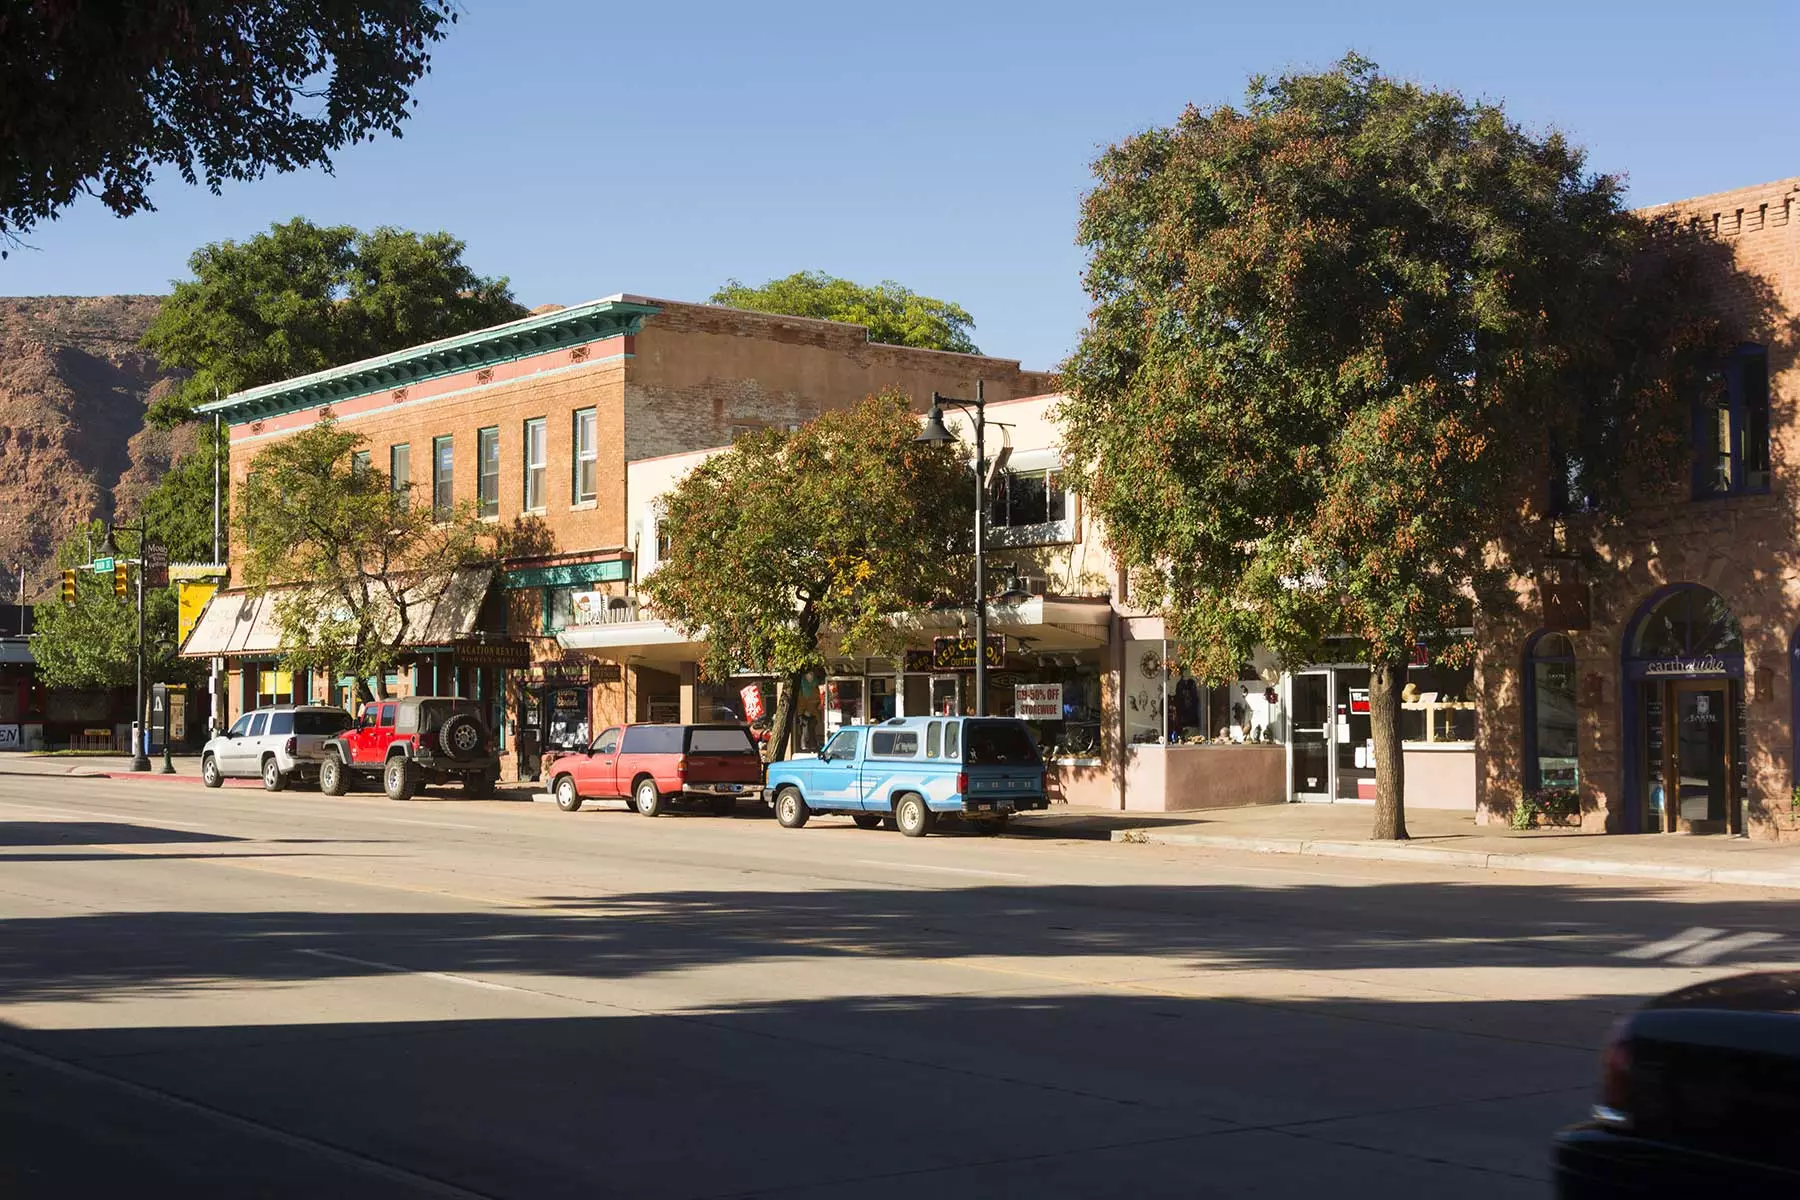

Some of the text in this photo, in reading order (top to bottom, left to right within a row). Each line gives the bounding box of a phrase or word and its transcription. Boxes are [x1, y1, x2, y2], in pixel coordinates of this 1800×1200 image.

[146, 543, 168, 554] Moab
[576, 608, 634, 626] URANIUM
[456, 645, 495, 656] VACATION
[937, 639, 1001, 666] RED CANON
[1047, 688, 1060, 700] OFF
[1020, 703, 1057, 715] STOREWIDE
